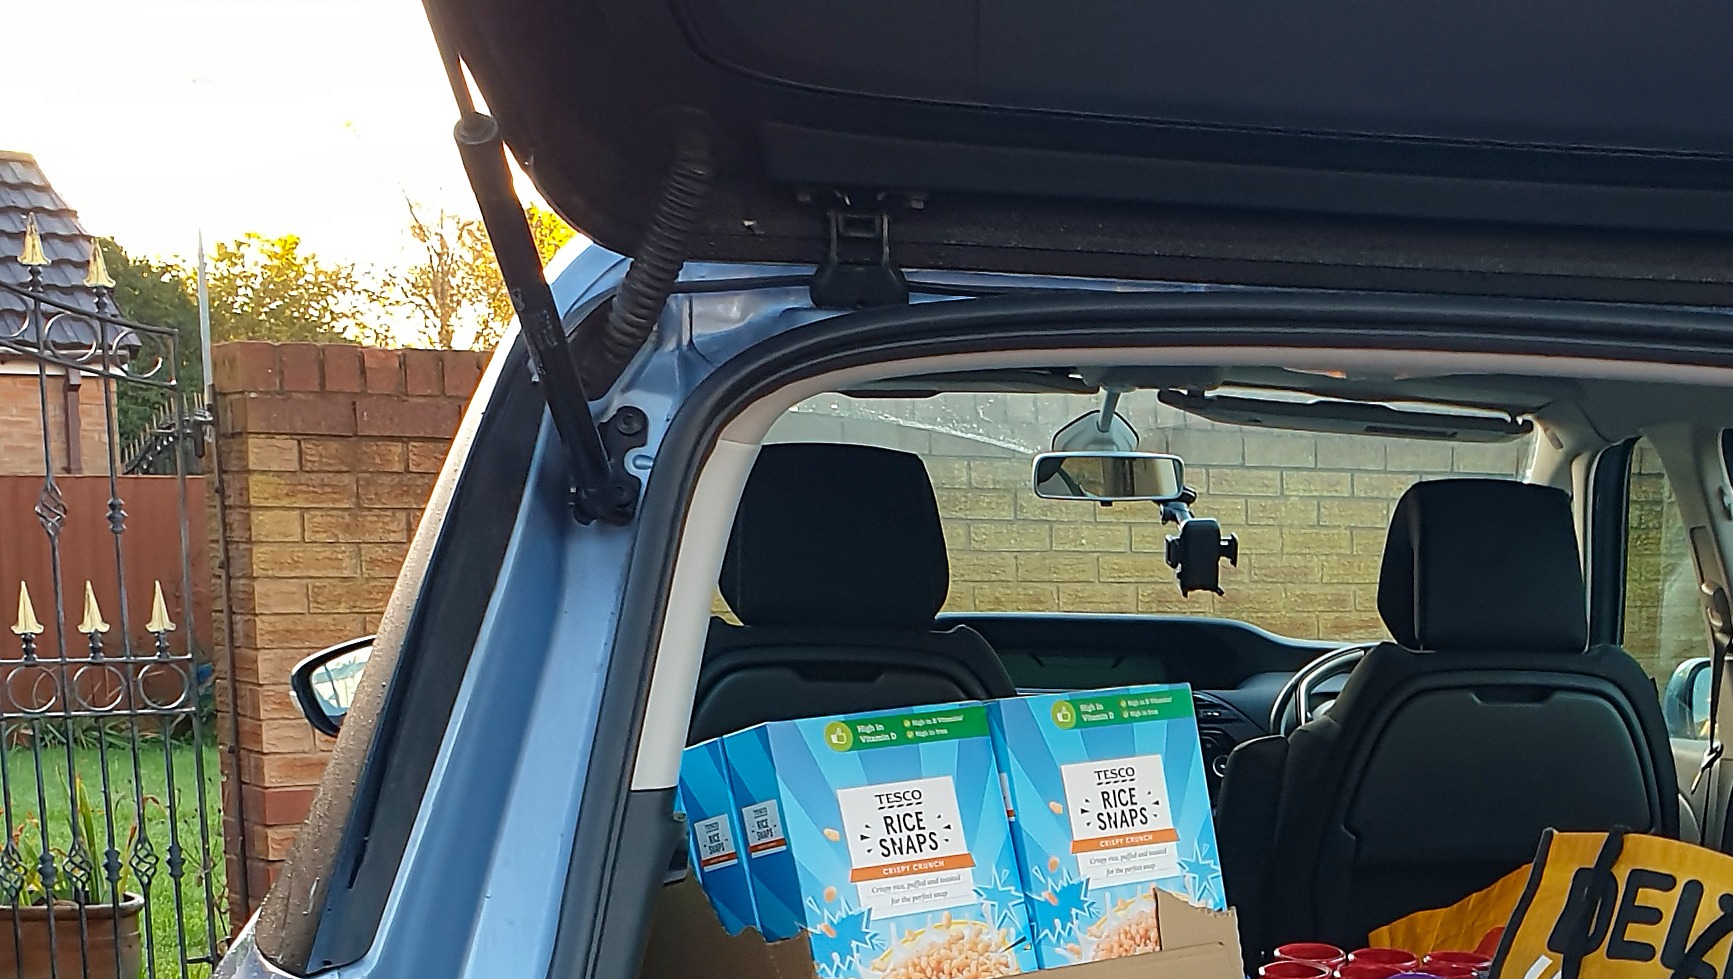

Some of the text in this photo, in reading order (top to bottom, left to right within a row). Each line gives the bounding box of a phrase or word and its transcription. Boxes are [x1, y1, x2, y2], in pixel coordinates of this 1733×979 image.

[860, 732, 897, 743] Vitamin D
[1094, 767, 1135, 781] TESCO
[874, 790, 922, 804] TESCO
[1101, 788, 1138, 809] RICE
[757, 818, 770, 830] RICE
[883, 811, 926, 835] RICE
[1097, 807, 1148, 830] SNAPS
[709, 832, 720, 844] RICE
[757, 828, 774, 840] SNAPS
[1100, 834, 1153, 847] CRISPY CRUNCH
[709, 842, 725, 854] SNAPS
[879, 832, 938, 858] SNAPS
[882, 860, 944, 876] CRISPY CRUNCH
